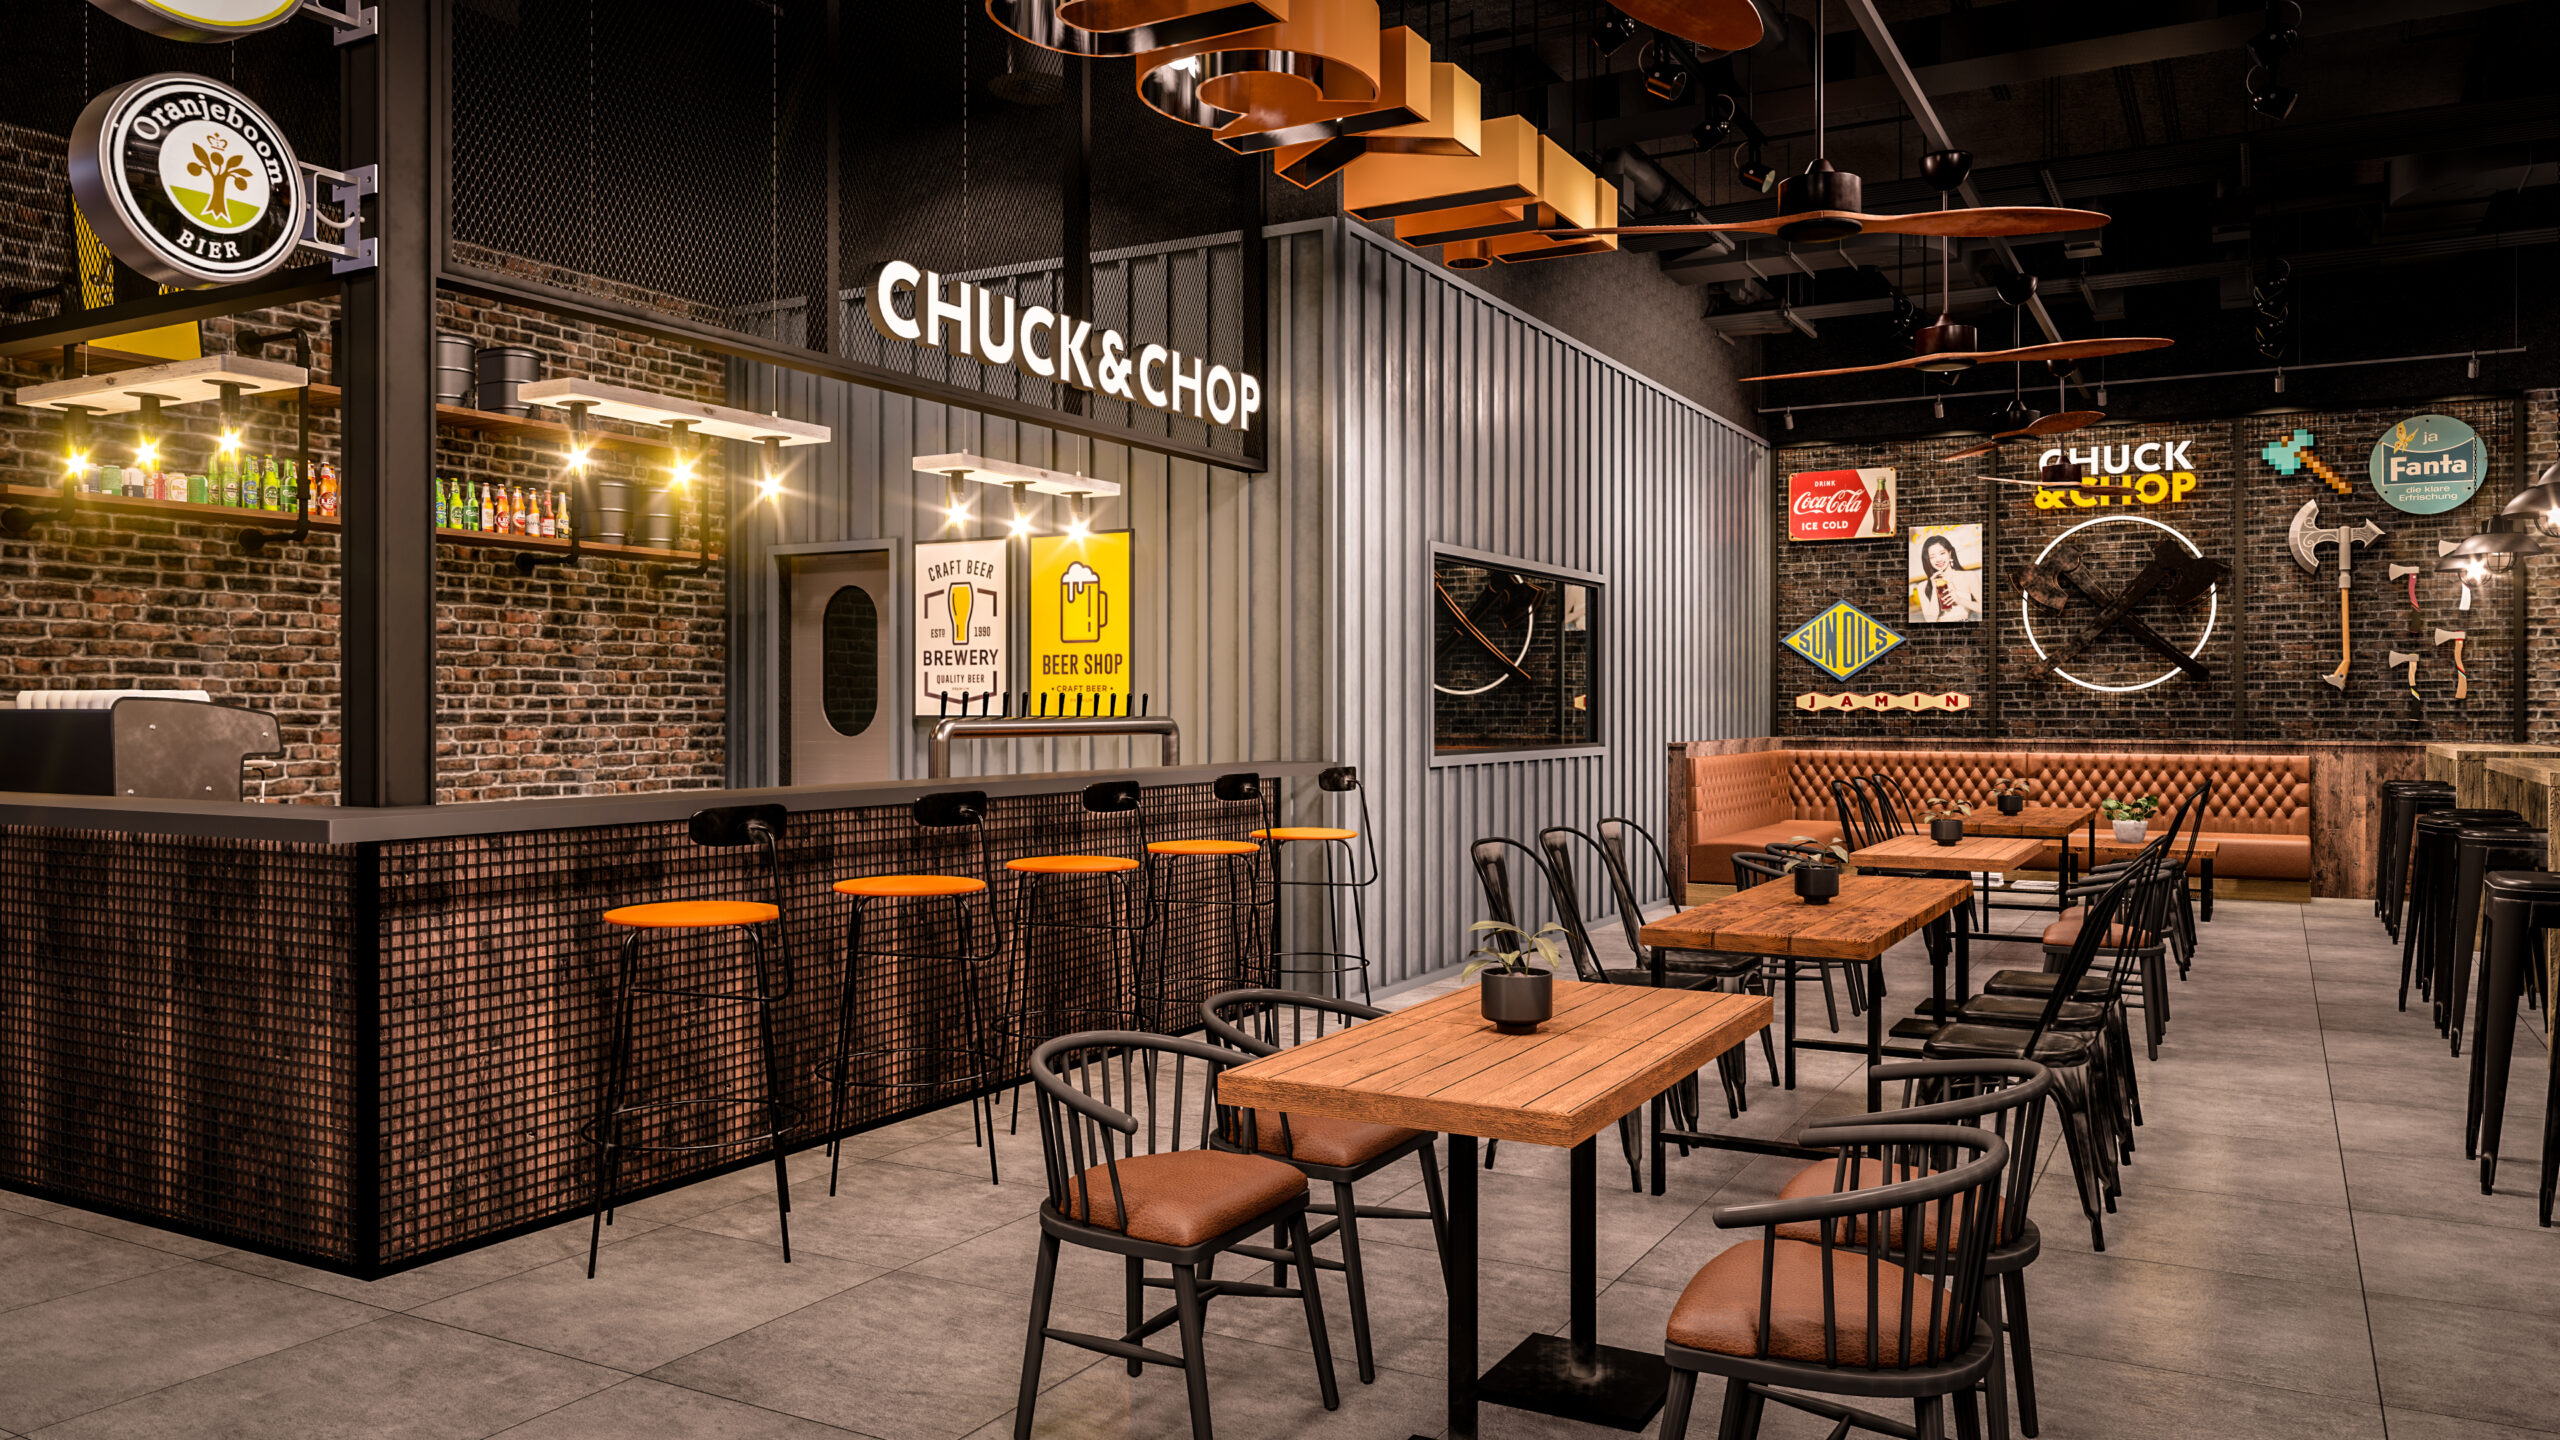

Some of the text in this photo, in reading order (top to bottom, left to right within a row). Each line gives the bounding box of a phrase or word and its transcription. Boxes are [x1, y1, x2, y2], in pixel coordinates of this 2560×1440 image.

[133, 94, 283, 185] Oranjeboom
[176, 229, 240, 259] BIER
[872, 259, 1261, 432] CHUCK&CHOP
[2422, 431, 2438, 445] ja
[2390, 454, 2467, 482] Fanta
[2399, 492, 2458, 501] Erfrischung
[2406, 485, 2450, 494] die klare
[1793, 489, 1865, 515] Coca-Cola
[1801, 520, 1849, 531] ICE COLD
[928, 559, 994, 582] CRAFT BEER
[974, 626, 991, 637] 1990
[1799, 611, 1888, 669] SUN OILS
[923, 649, 998, 666] BREWERY
[1042, 653, 1123, 675] BEER SHOP
[936, 674, 985, 684] QUALITY BEER
[1808, 695, 1959, 709] JAMIN
